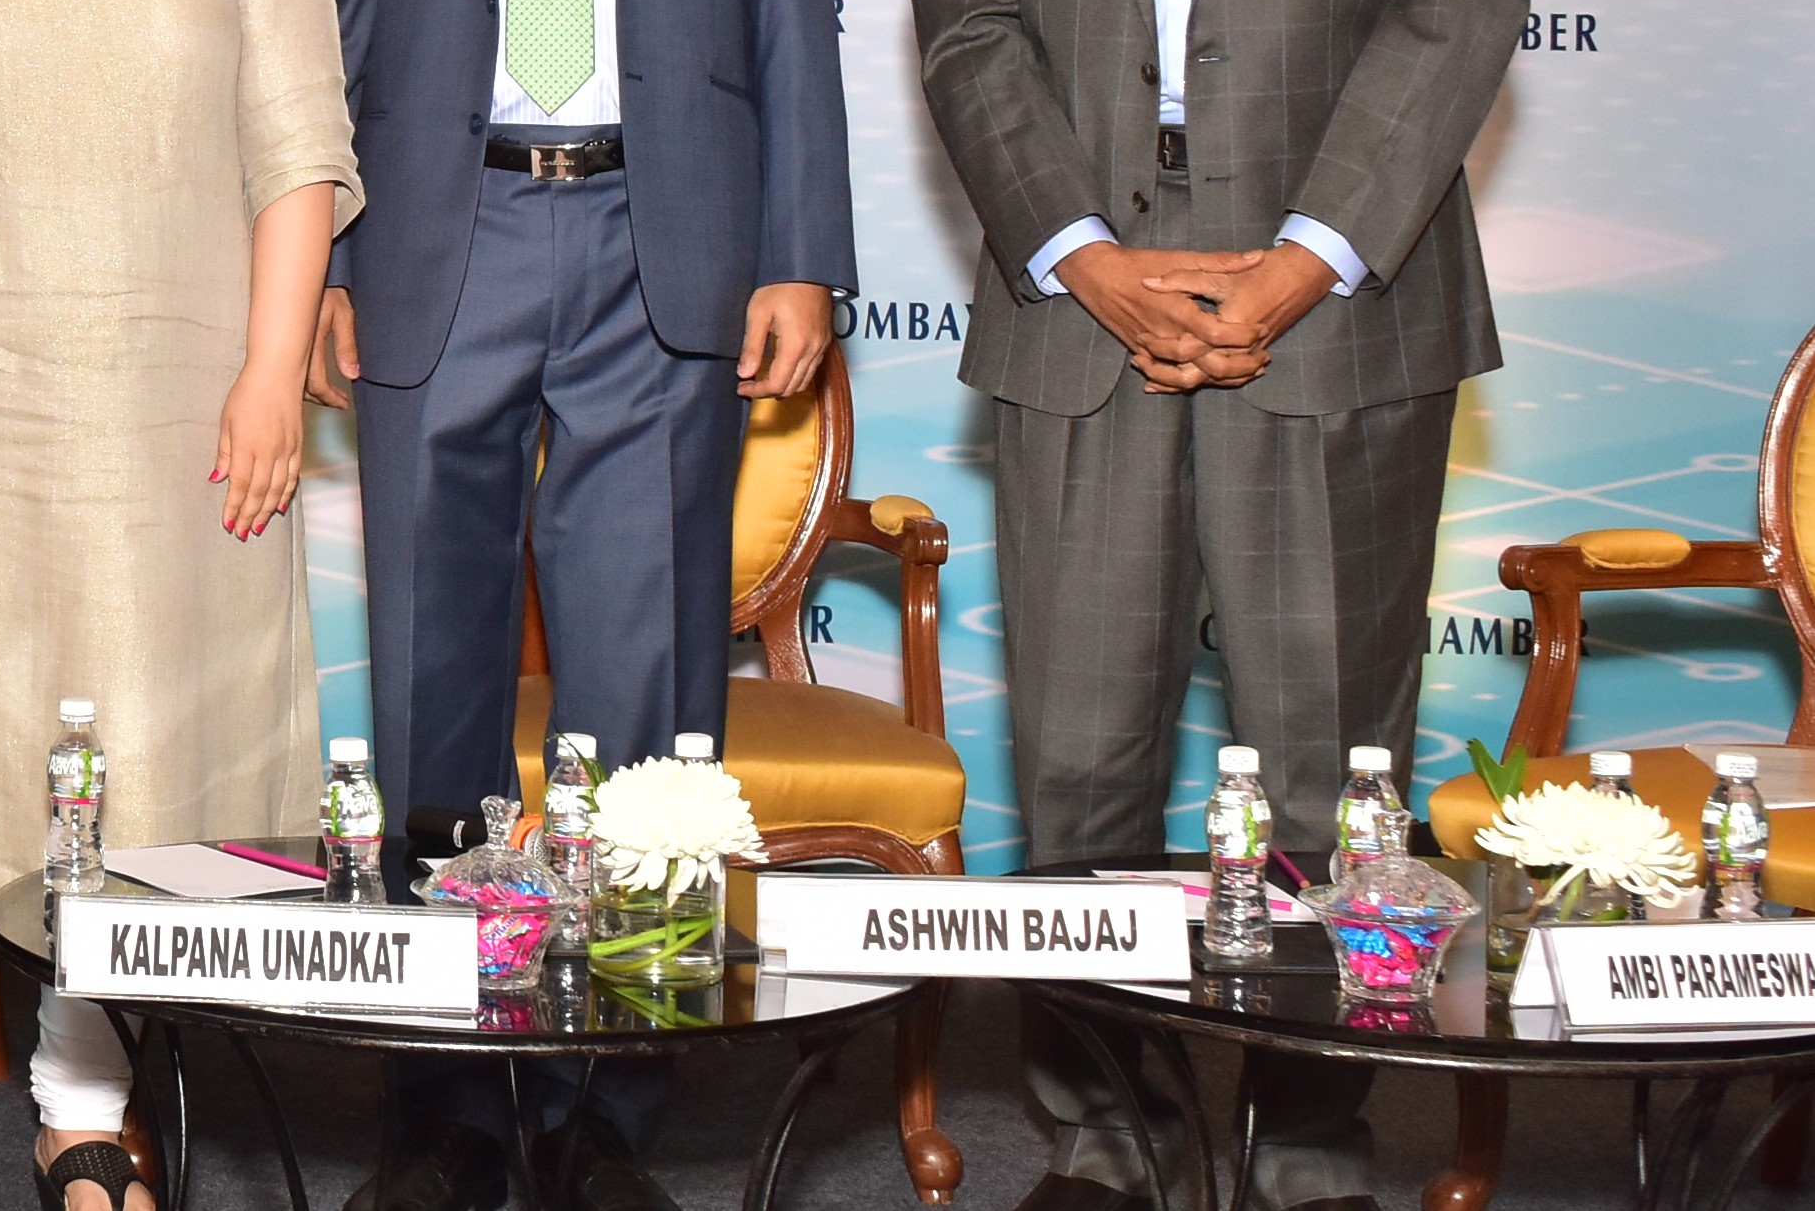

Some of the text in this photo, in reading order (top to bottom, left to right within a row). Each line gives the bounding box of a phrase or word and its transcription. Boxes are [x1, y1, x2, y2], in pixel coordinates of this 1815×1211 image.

[863, 909, 1137, 952] ASHWIN BAJAJ
[111, 924, 410, 983] KALPANA UNADKAT
[1609, 955, 1670, 999] AMBI
